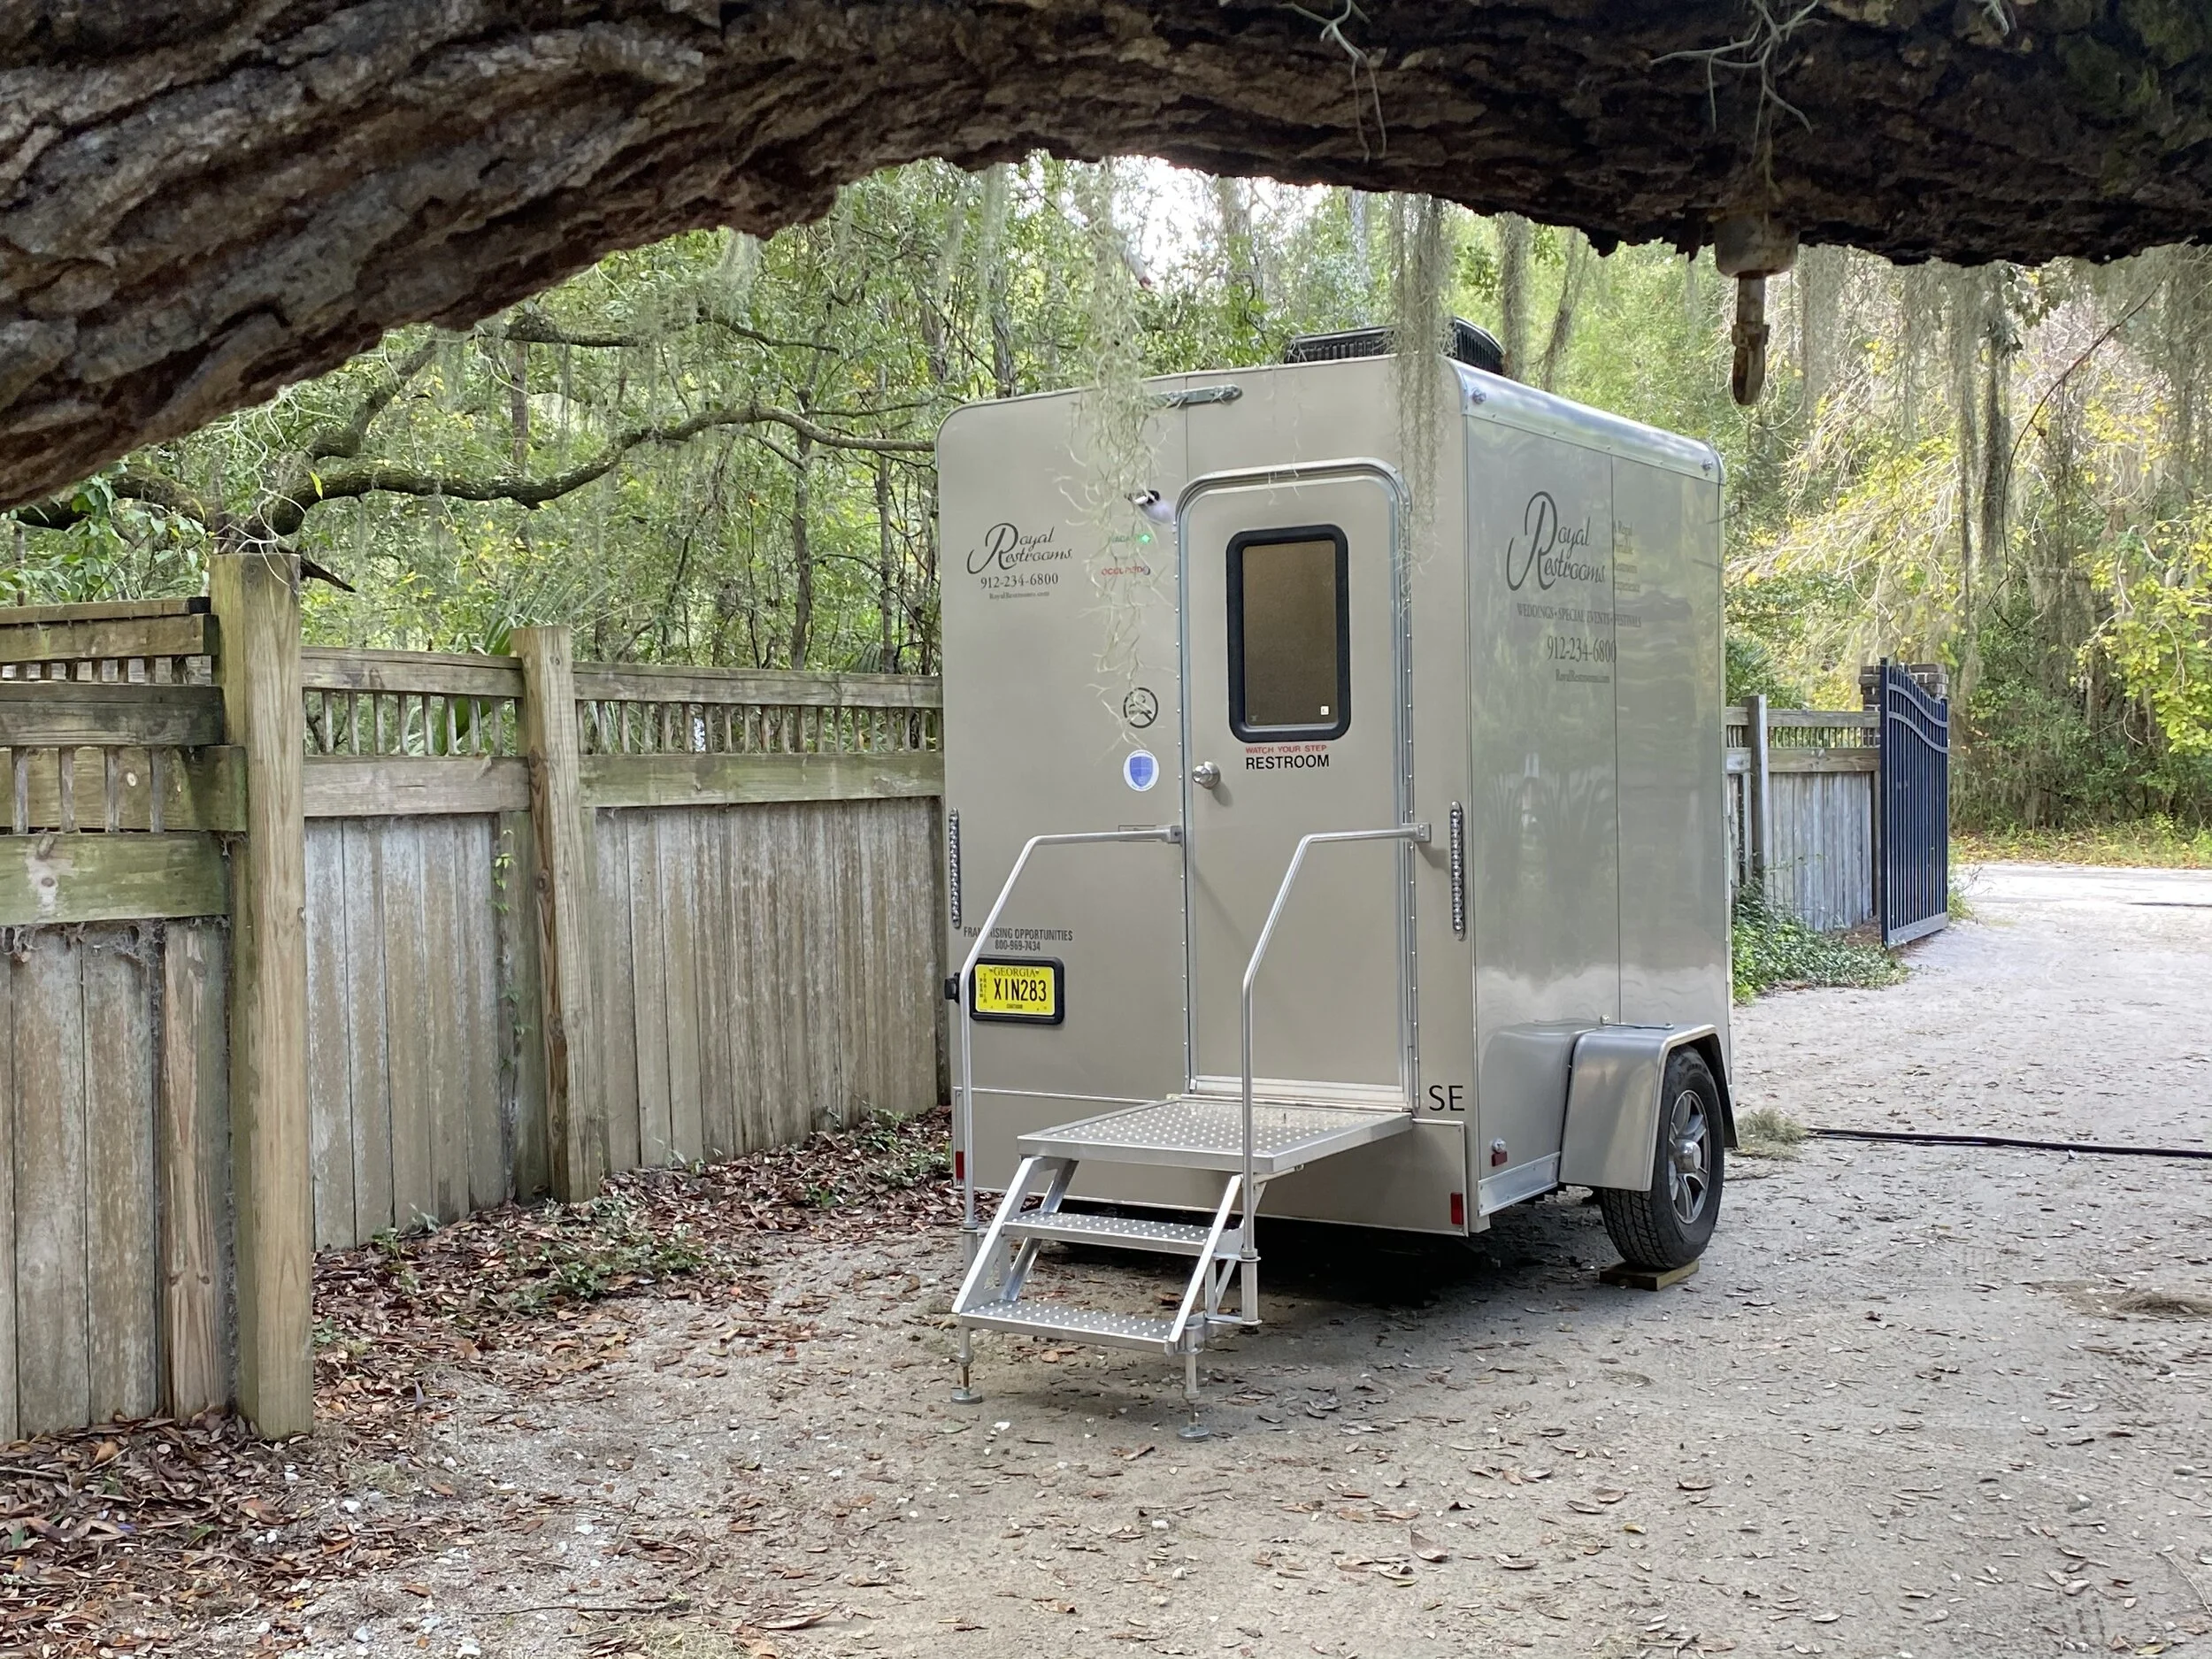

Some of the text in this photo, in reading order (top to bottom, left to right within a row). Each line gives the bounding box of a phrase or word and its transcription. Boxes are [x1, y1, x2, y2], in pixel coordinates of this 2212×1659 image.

[998, 547, 1071, 571] Restrooms
[980, 572, 1059, 588] 912-234-6800
[1547, 634, 1617, 663] 912-234-6800
[1246, 743, 1327, 755] WATCH YOUR STEP
[1246, 754, 1330, 770] RESTROOM
[1015, 928, 1073, 941] OPPORTUNITIES
[993, 966, 1036, 978] GEORGIA
[994, 978, 1047, 1002] XIN283
[1429, 1085, 1465, 1111] SE
